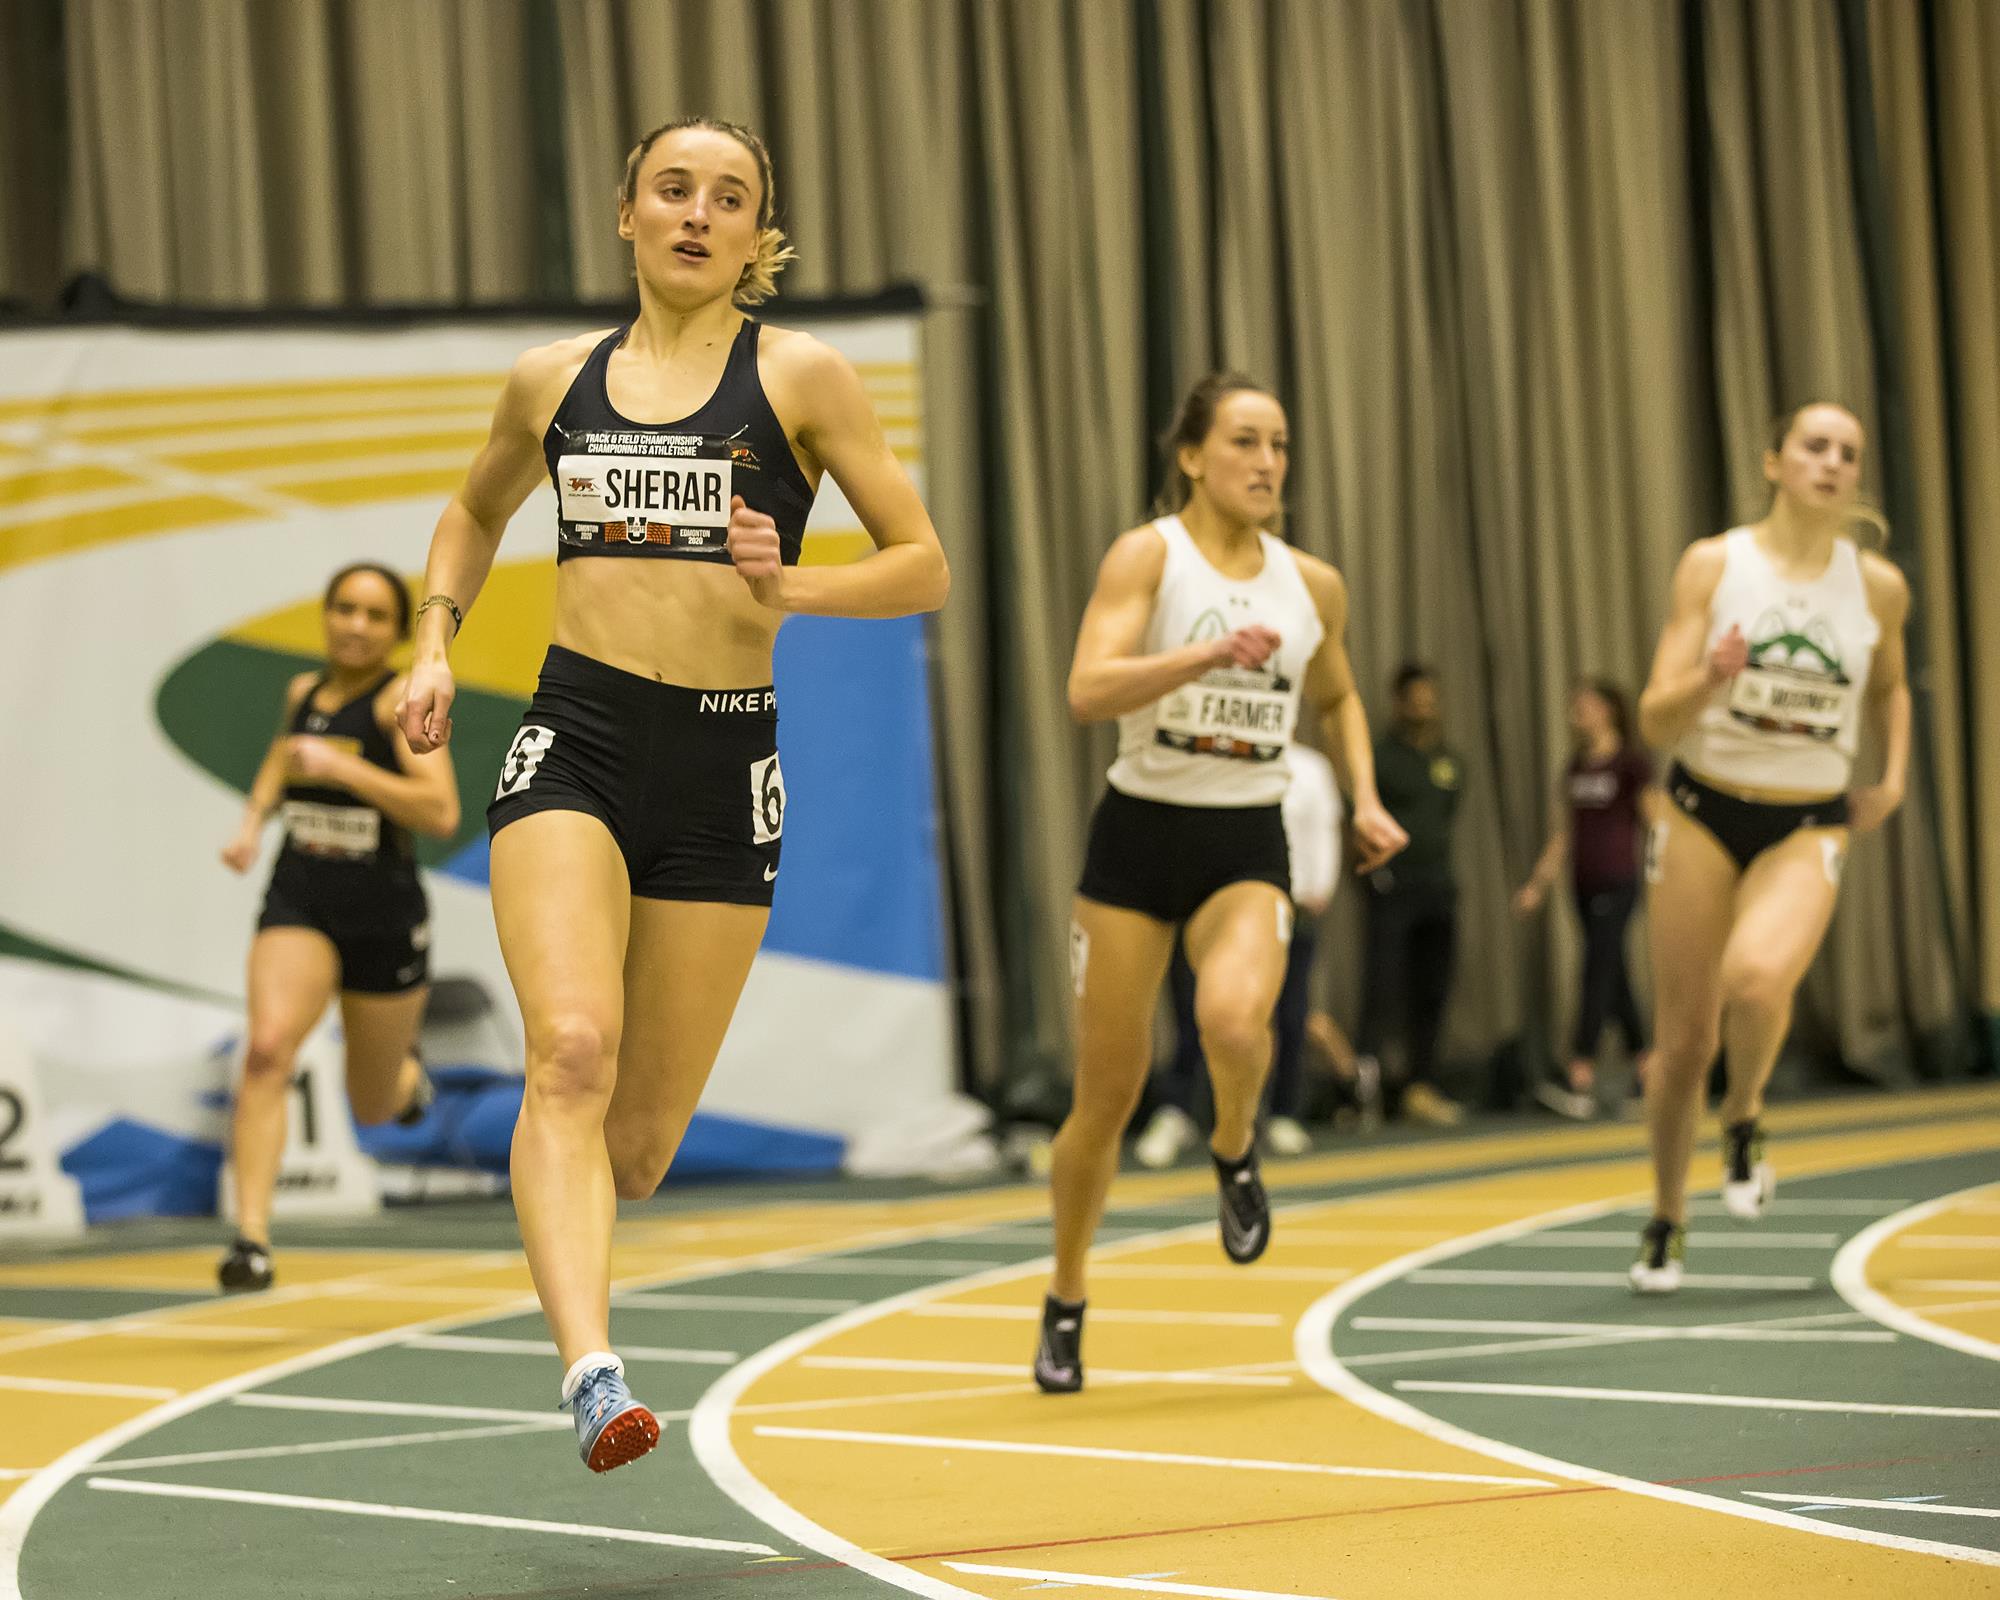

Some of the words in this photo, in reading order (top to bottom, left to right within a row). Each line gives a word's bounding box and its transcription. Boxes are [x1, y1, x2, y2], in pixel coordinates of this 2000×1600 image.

[585, 433, 611, 444] TRACK
[610, 434, 618, 444] &
[617, 434, 640, 445] FIELD
[639, 434, 703, 446] CHAMPIONSHIPS
[587, 443, 648, 455] CHAMPIONNATS
[604, 468, 722, 513] SHERAR
[575, 524, 599, 533] EDMONTON
[679, 528, 711, 538] EDMONTON
[688, 537, 704, 545] 2020
[699, 693, 760, 713] NIKE
[1200, 694, 1284, 732] FARMER
[761, 758, 781, 835] 6
[289, 1068, 316, 1148] 1
